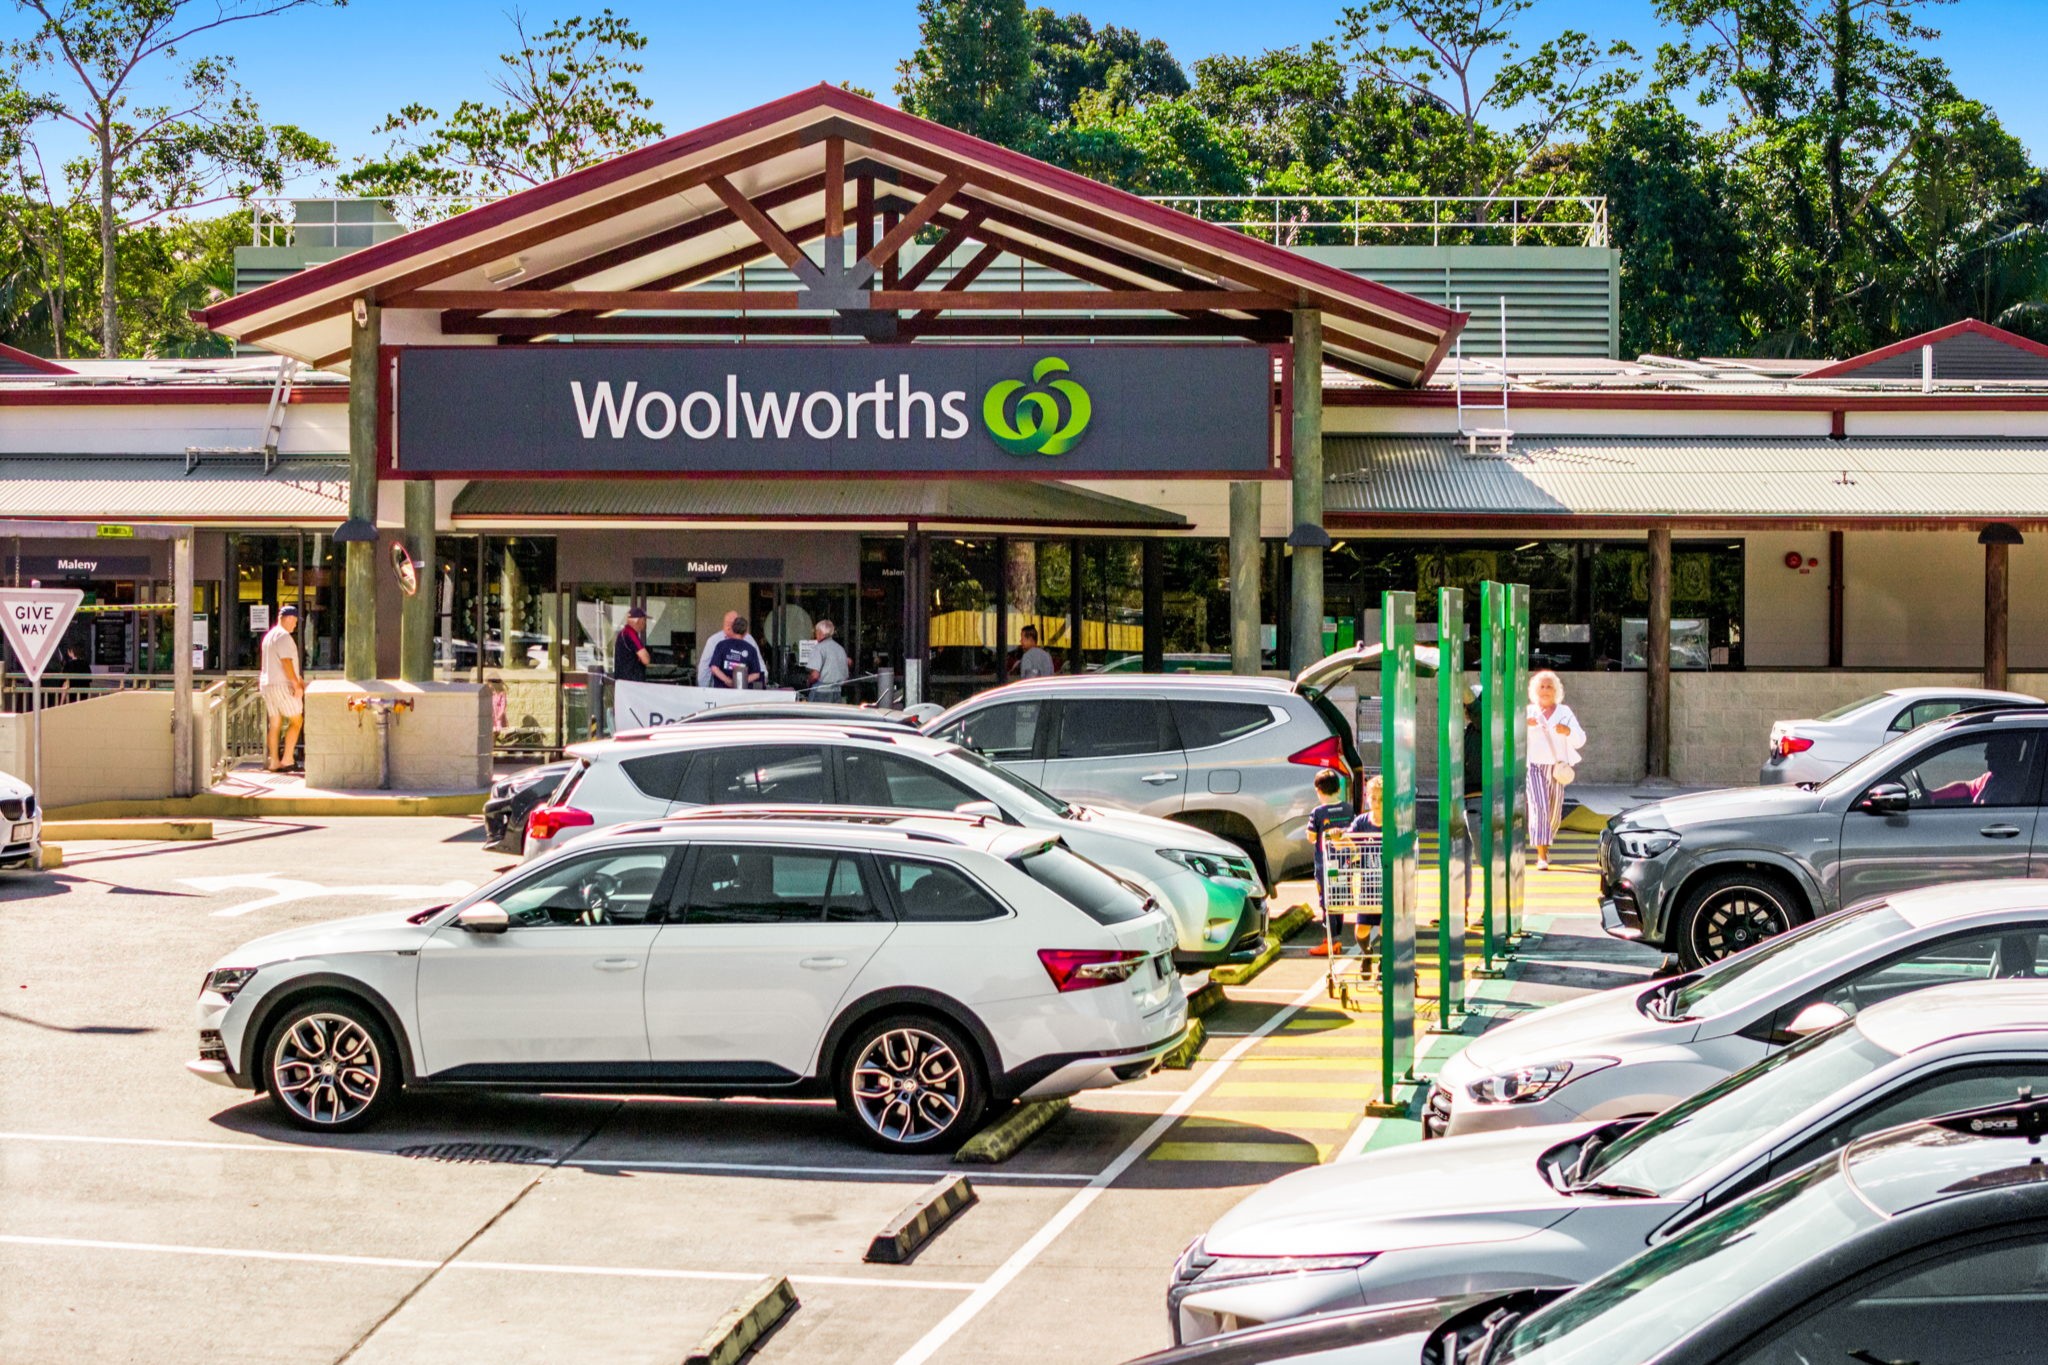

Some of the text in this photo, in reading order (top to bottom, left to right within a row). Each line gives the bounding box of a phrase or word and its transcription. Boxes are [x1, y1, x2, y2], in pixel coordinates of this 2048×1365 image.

[570, 374, 969, 440] Woolworths
[58, 560, 97, 572] Maleny
[687, 562, 728, 575] Maleny
[882, 568, 905, 577] Malen
[15, 606, 54, 620] GIVE
[21, 624, 47, 635] WAY
